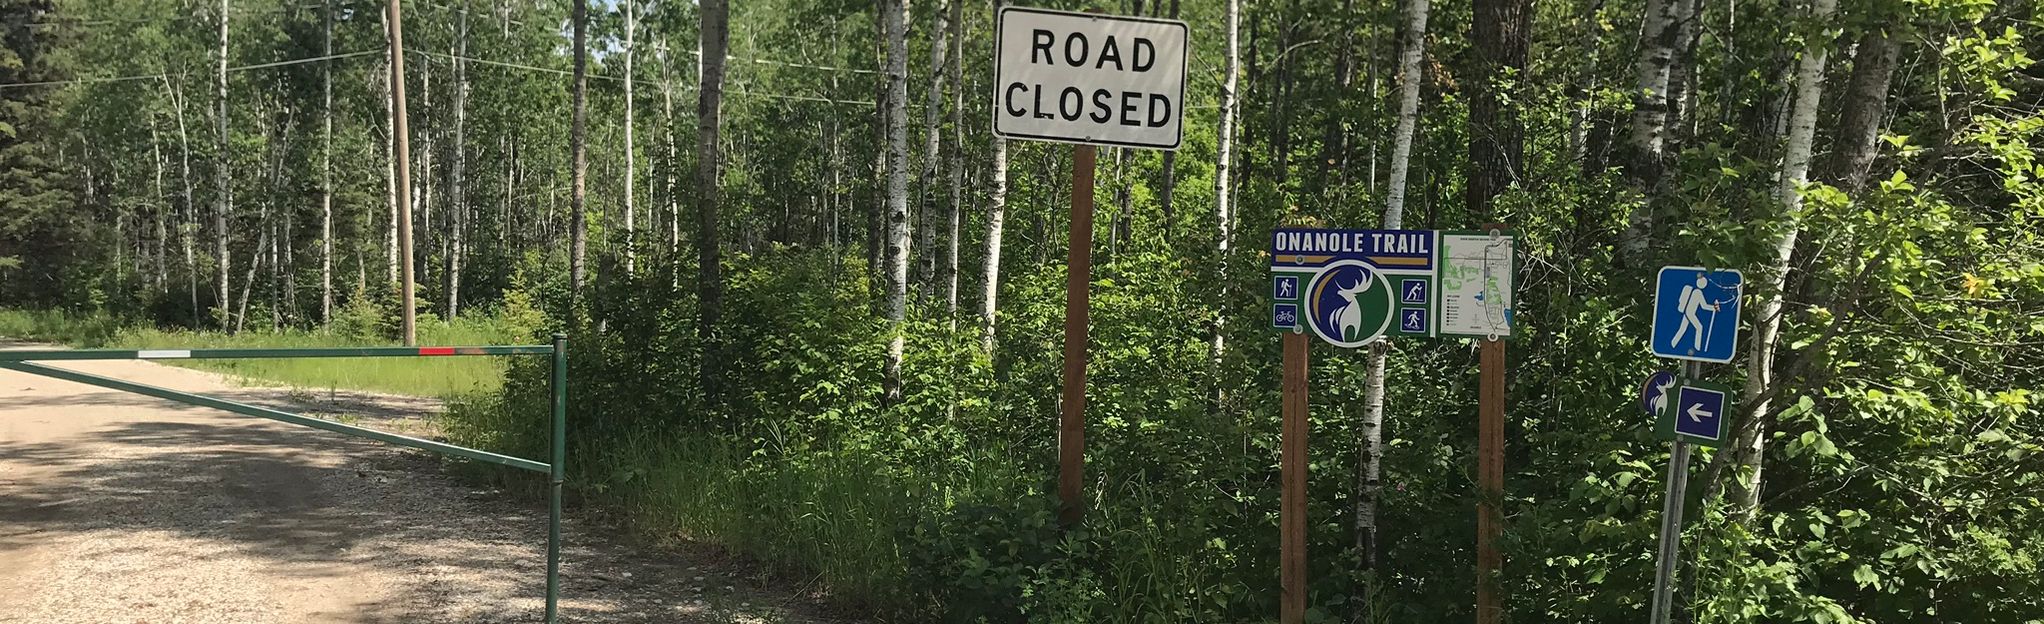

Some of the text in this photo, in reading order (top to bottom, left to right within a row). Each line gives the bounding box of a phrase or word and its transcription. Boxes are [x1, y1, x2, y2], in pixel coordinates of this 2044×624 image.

[1031, 28, 1156, 73] ROAD
[1005, 81, 1172, 128] CLOSED
[1275, 231, 1429, 254] ONANOLE TRAIL
